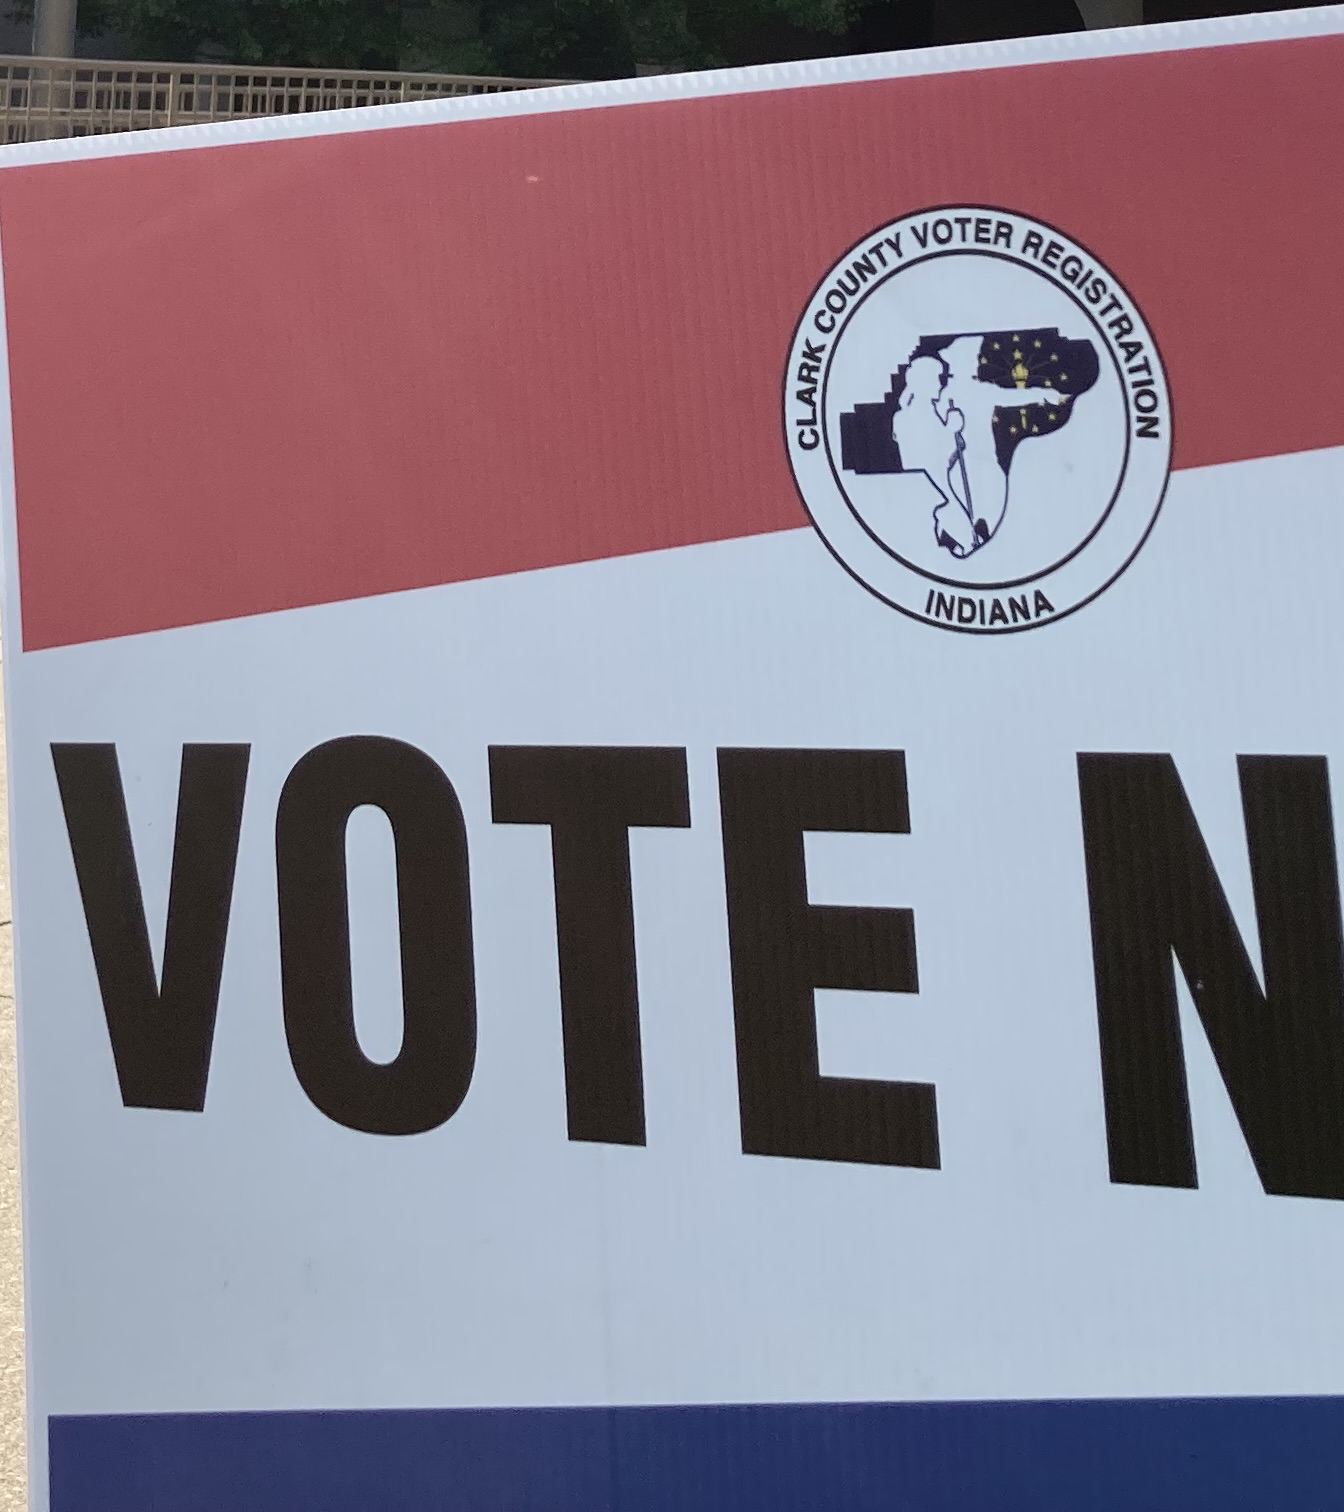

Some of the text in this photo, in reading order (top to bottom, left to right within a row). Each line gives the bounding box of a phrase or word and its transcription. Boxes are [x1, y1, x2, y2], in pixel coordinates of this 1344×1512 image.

[797, 217, 1160, 451] CLARK COUNTY VOTER REGISTRATION
[924, 588, 1055, 626] INDIANA
[50, 735, 941, 1171] VOTE
